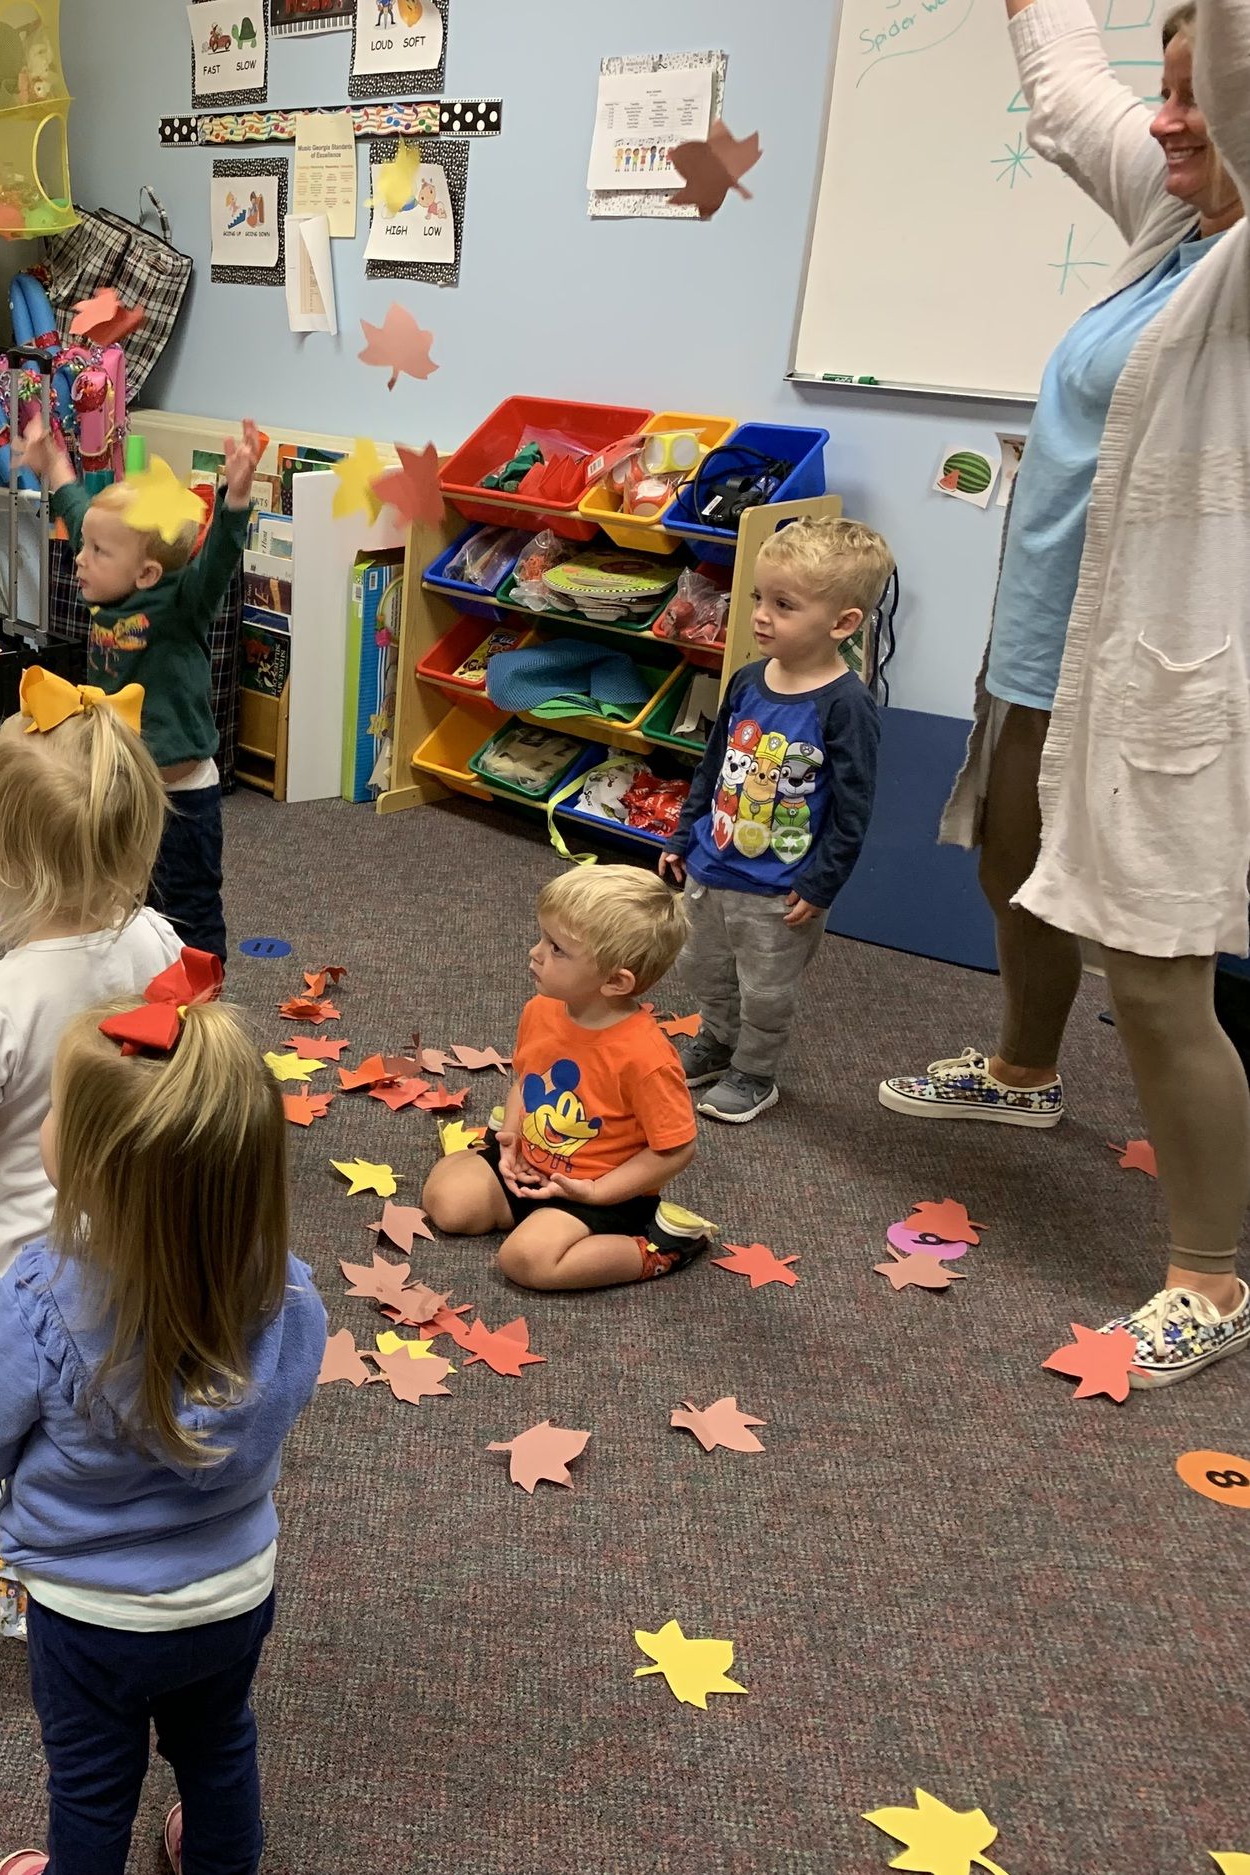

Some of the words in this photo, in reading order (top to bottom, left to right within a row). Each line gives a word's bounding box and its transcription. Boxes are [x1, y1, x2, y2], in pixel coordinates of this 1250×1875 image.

[859, 14, 916, 54] Spider
[371, 39, 394, 51] LOUD
[403, 36, 426, 48] SOFT
[203, 64, 221, 76] FAST
[236, 60, 257, 71] SLOW
[385, 225, 408, 235] HIGH
[423, 226, 442, 236] LOW
[253, 942, 276, 954] 11
[1206, 1470, 1250, 1488] 8
